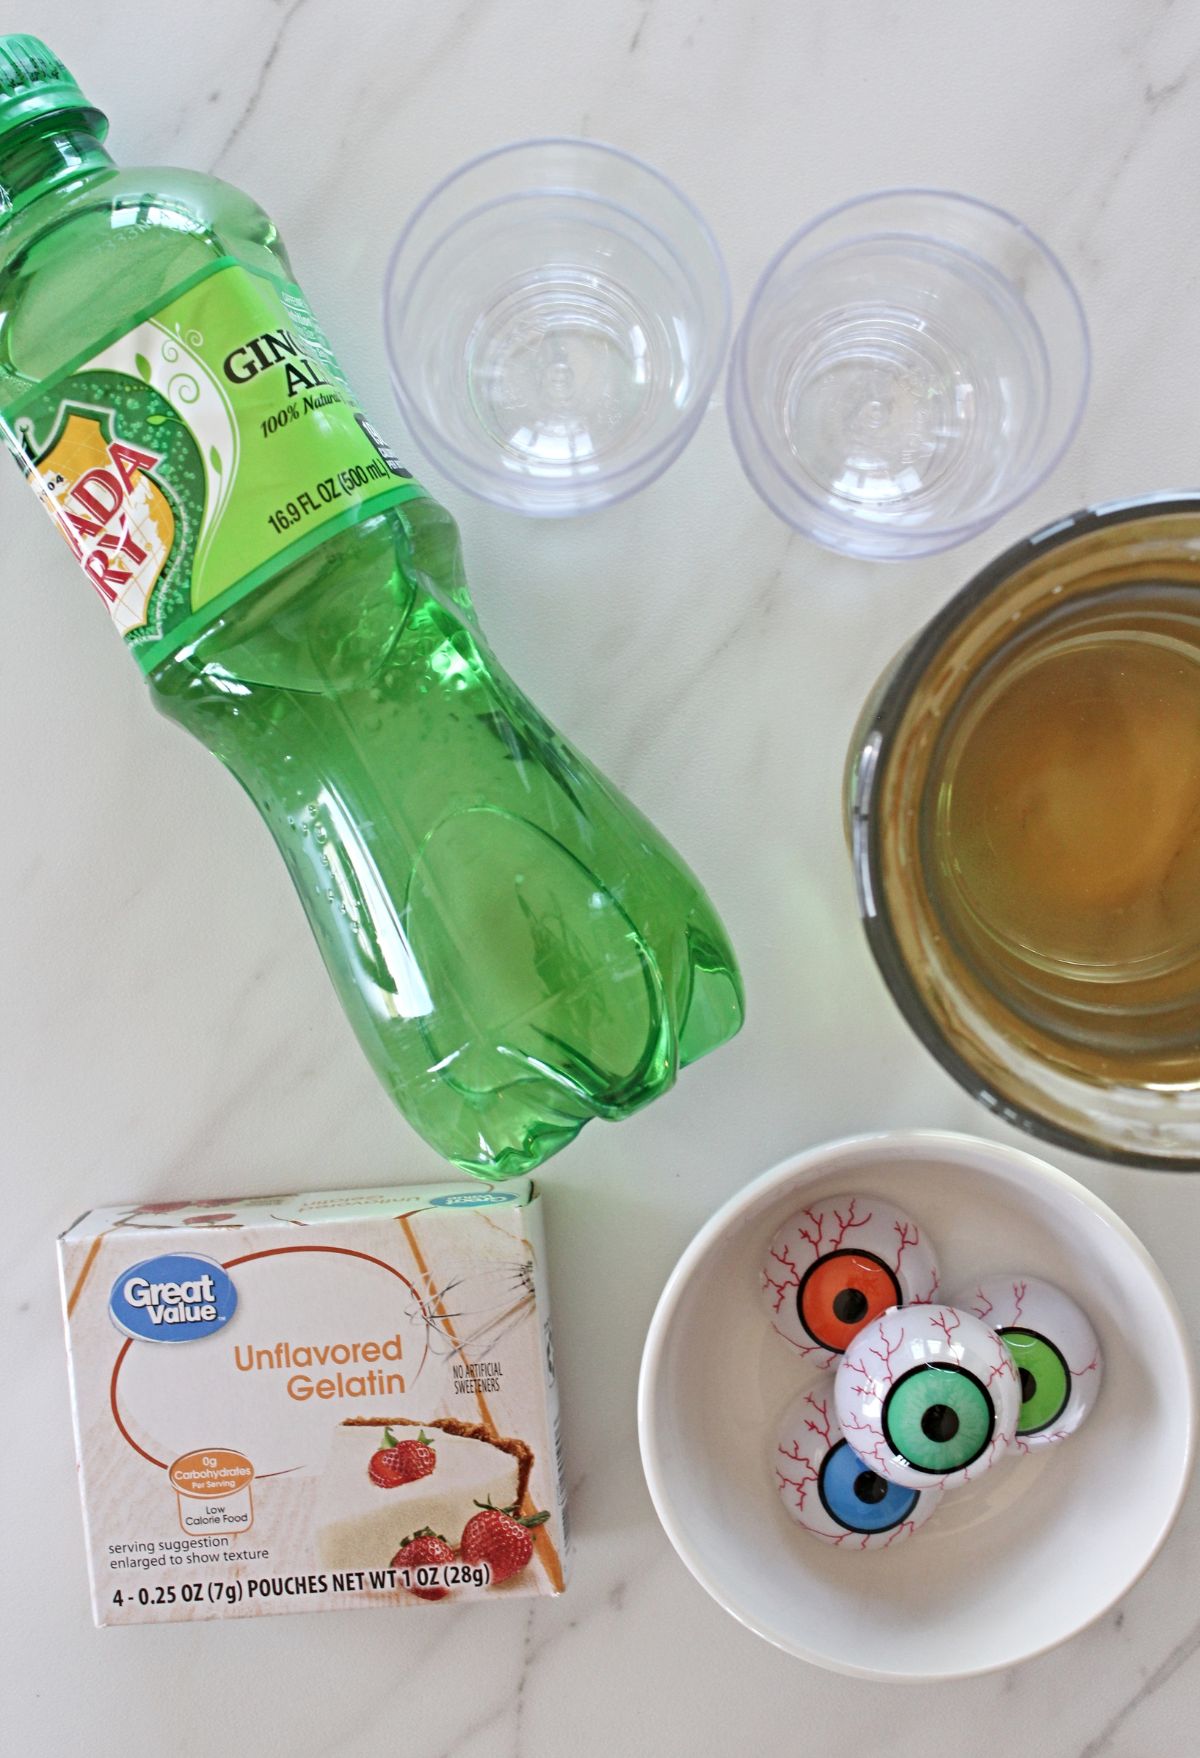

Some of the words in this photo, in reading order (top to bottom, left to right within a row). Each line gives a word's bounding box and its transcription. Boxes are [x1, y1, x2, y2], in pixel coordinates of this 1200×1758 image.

[284, 359, 334, 398] AL
[260, 404, 300, 438] 100%
[268, 502, 301, 534] 16.9
[299, 490, 321, 515] FL
[318, 477, 342, 502] OZ
[337, 465, 369, 495] (500
[366, 458, 391, 480] mL)
[84, 513, 148, 603] RY
[123, 1275, 216, 1308] Great
[146, 1301, 217, 1325] Value
[234, 1334, 403, 1372] Unflavored
[452, 1364, 463, 1379] NO
[465, 1361, 503, 1378] ARTIFICIAL
[286, 1369, 406, 1401] Gelatin
[454, 1377, 501, 1394] SWEETENERS
[174, 1467, 252, 1480] Carbohydrates
[202, 1456, 217, 1468] 0g
[207, 1480, 236, 1488] Serving
[185, 1515, 220, 1525] Calorie
[222, 1513, 248, 1522] Food
[206, 1505, 225, 1514] Low
[108, 1540, 155, 1554] serving
[158, 1536, 229, 1553] suggestion
[110, 1552, 167, 1570] enlarged
[170, 1554, 183, 1566] to
[186, 1549, 220, 1564] show
[223, 1548, 269, 1563] texture
[112, 1589, 124, 1606] 4
[138, 1586, 176, 1605] 0.25
[181, 1584, 204, 1602] OZ
[208, 1581, 243, 1604] (7g)
[247, 1574, 328, 1598] POUCHES
[332, 1572, 364, 1592] NET
[369, 1569, 397, 1589] WT
[402, 1570, 411, 1587] 1
[417, 1567, 440, 1586] OZ
[443, 1563, 490, 1588] (28g)
